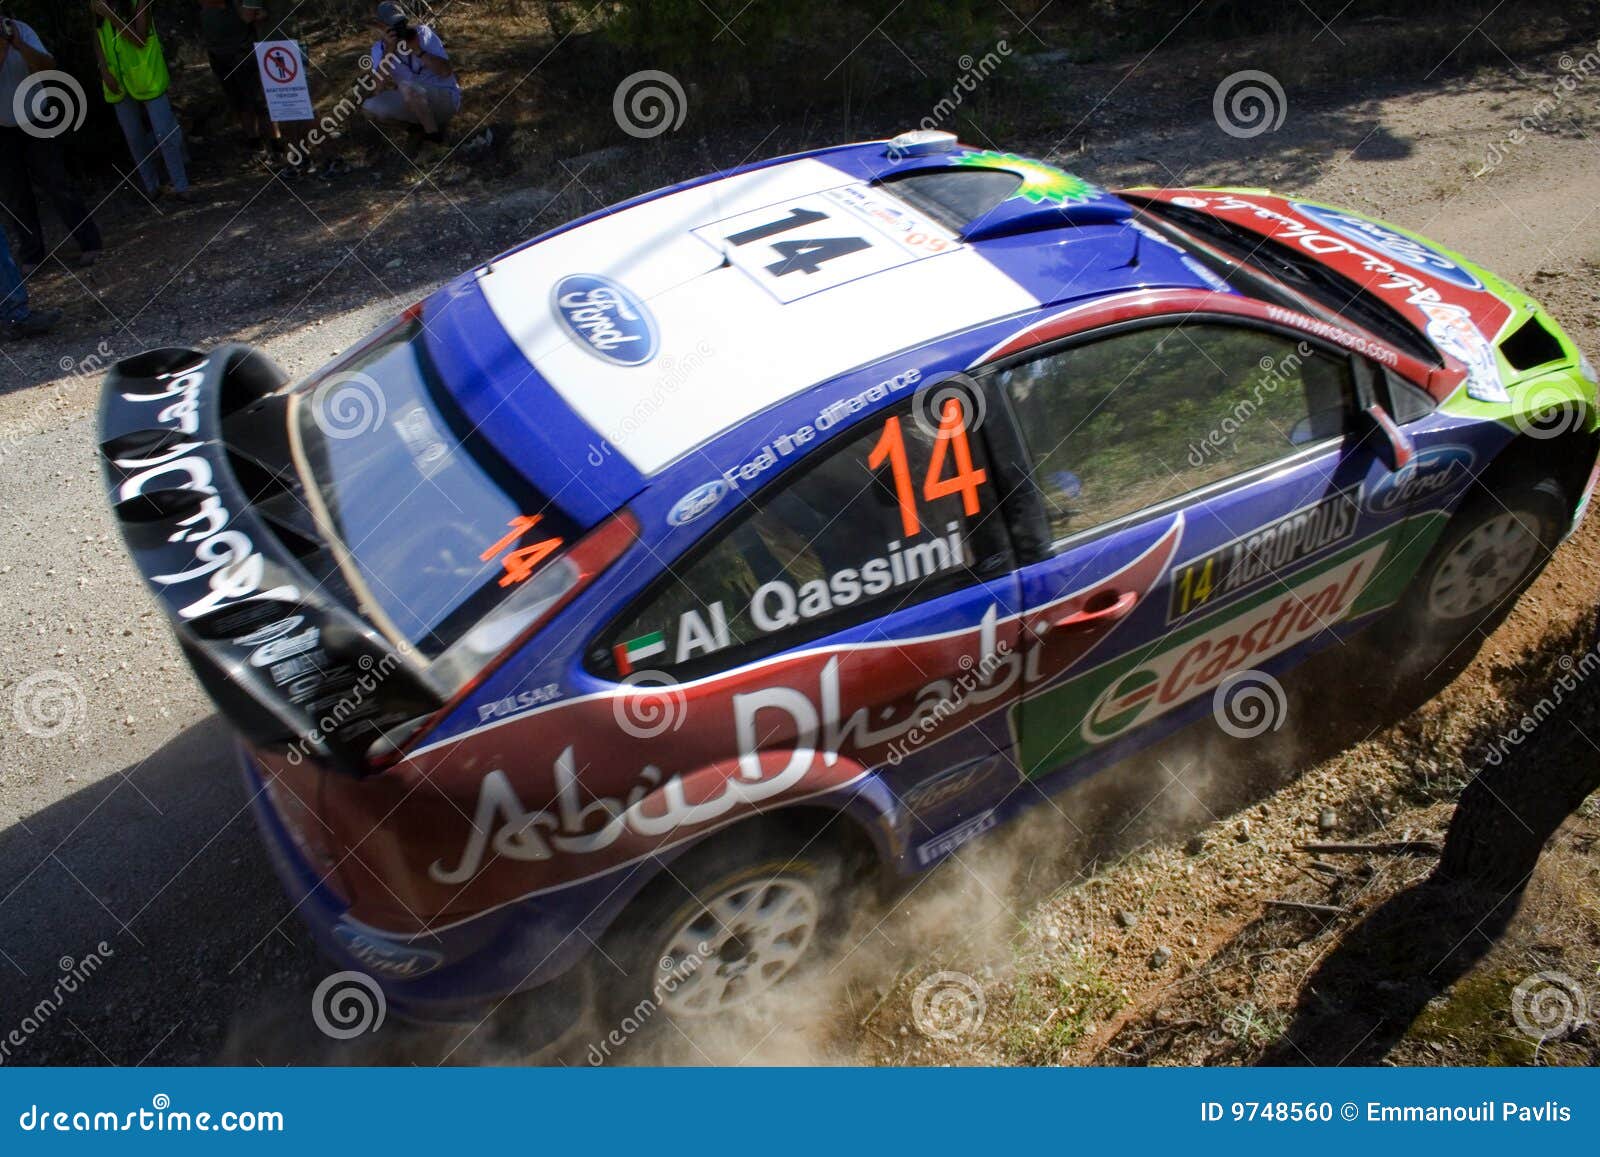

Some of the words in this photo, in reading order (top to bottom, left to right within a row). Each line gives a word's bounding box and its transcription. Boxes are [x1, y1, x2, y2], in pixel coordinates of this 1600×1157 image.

[725, 208, 872, 277] 14
[558, 287, 641, 352] Ford
[723, 445, 779, 490] Feel
[774, 424, 816, 456] the
[815, 368, 922, 431] difference
[868, 397, 987, 539] 14
[1383, 455, 1458, 509] Ford
[480, 513, 564, 588] 14
[675, 600, 731, 665] Al
[749, 520, 968, 633] Qassimi
[1179, 557, 1214, 614] 14
[1224, 492, 1352, 592] ACROPOLIS
[1160, 560, 1364, 702] Castrol
